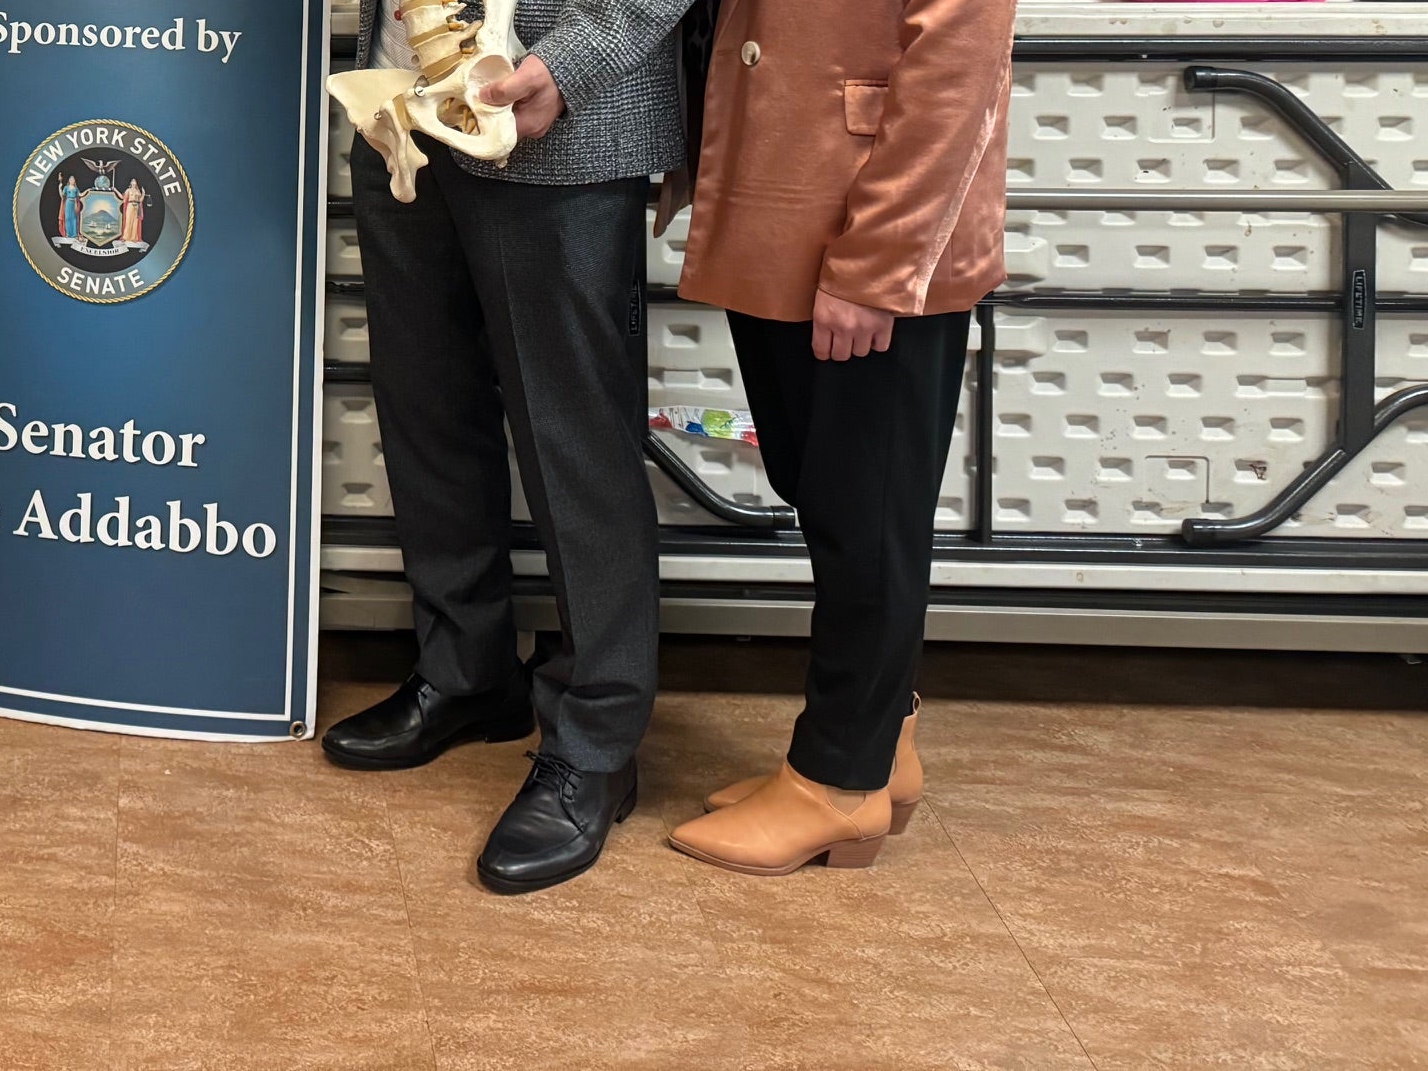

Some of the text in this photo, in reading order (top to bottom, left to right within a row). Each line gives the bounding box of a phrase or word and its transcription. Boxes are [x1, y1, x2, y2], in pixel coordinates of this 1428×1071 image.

[196, 18, 243, 64] by
[26, 127, 182, 197] NEW YORK STATE
[57, 266, 145, 295] SENATE
[1355, 276, 1363, 324] LIFETIME
[13, 489, 277, 558] Addabbo
